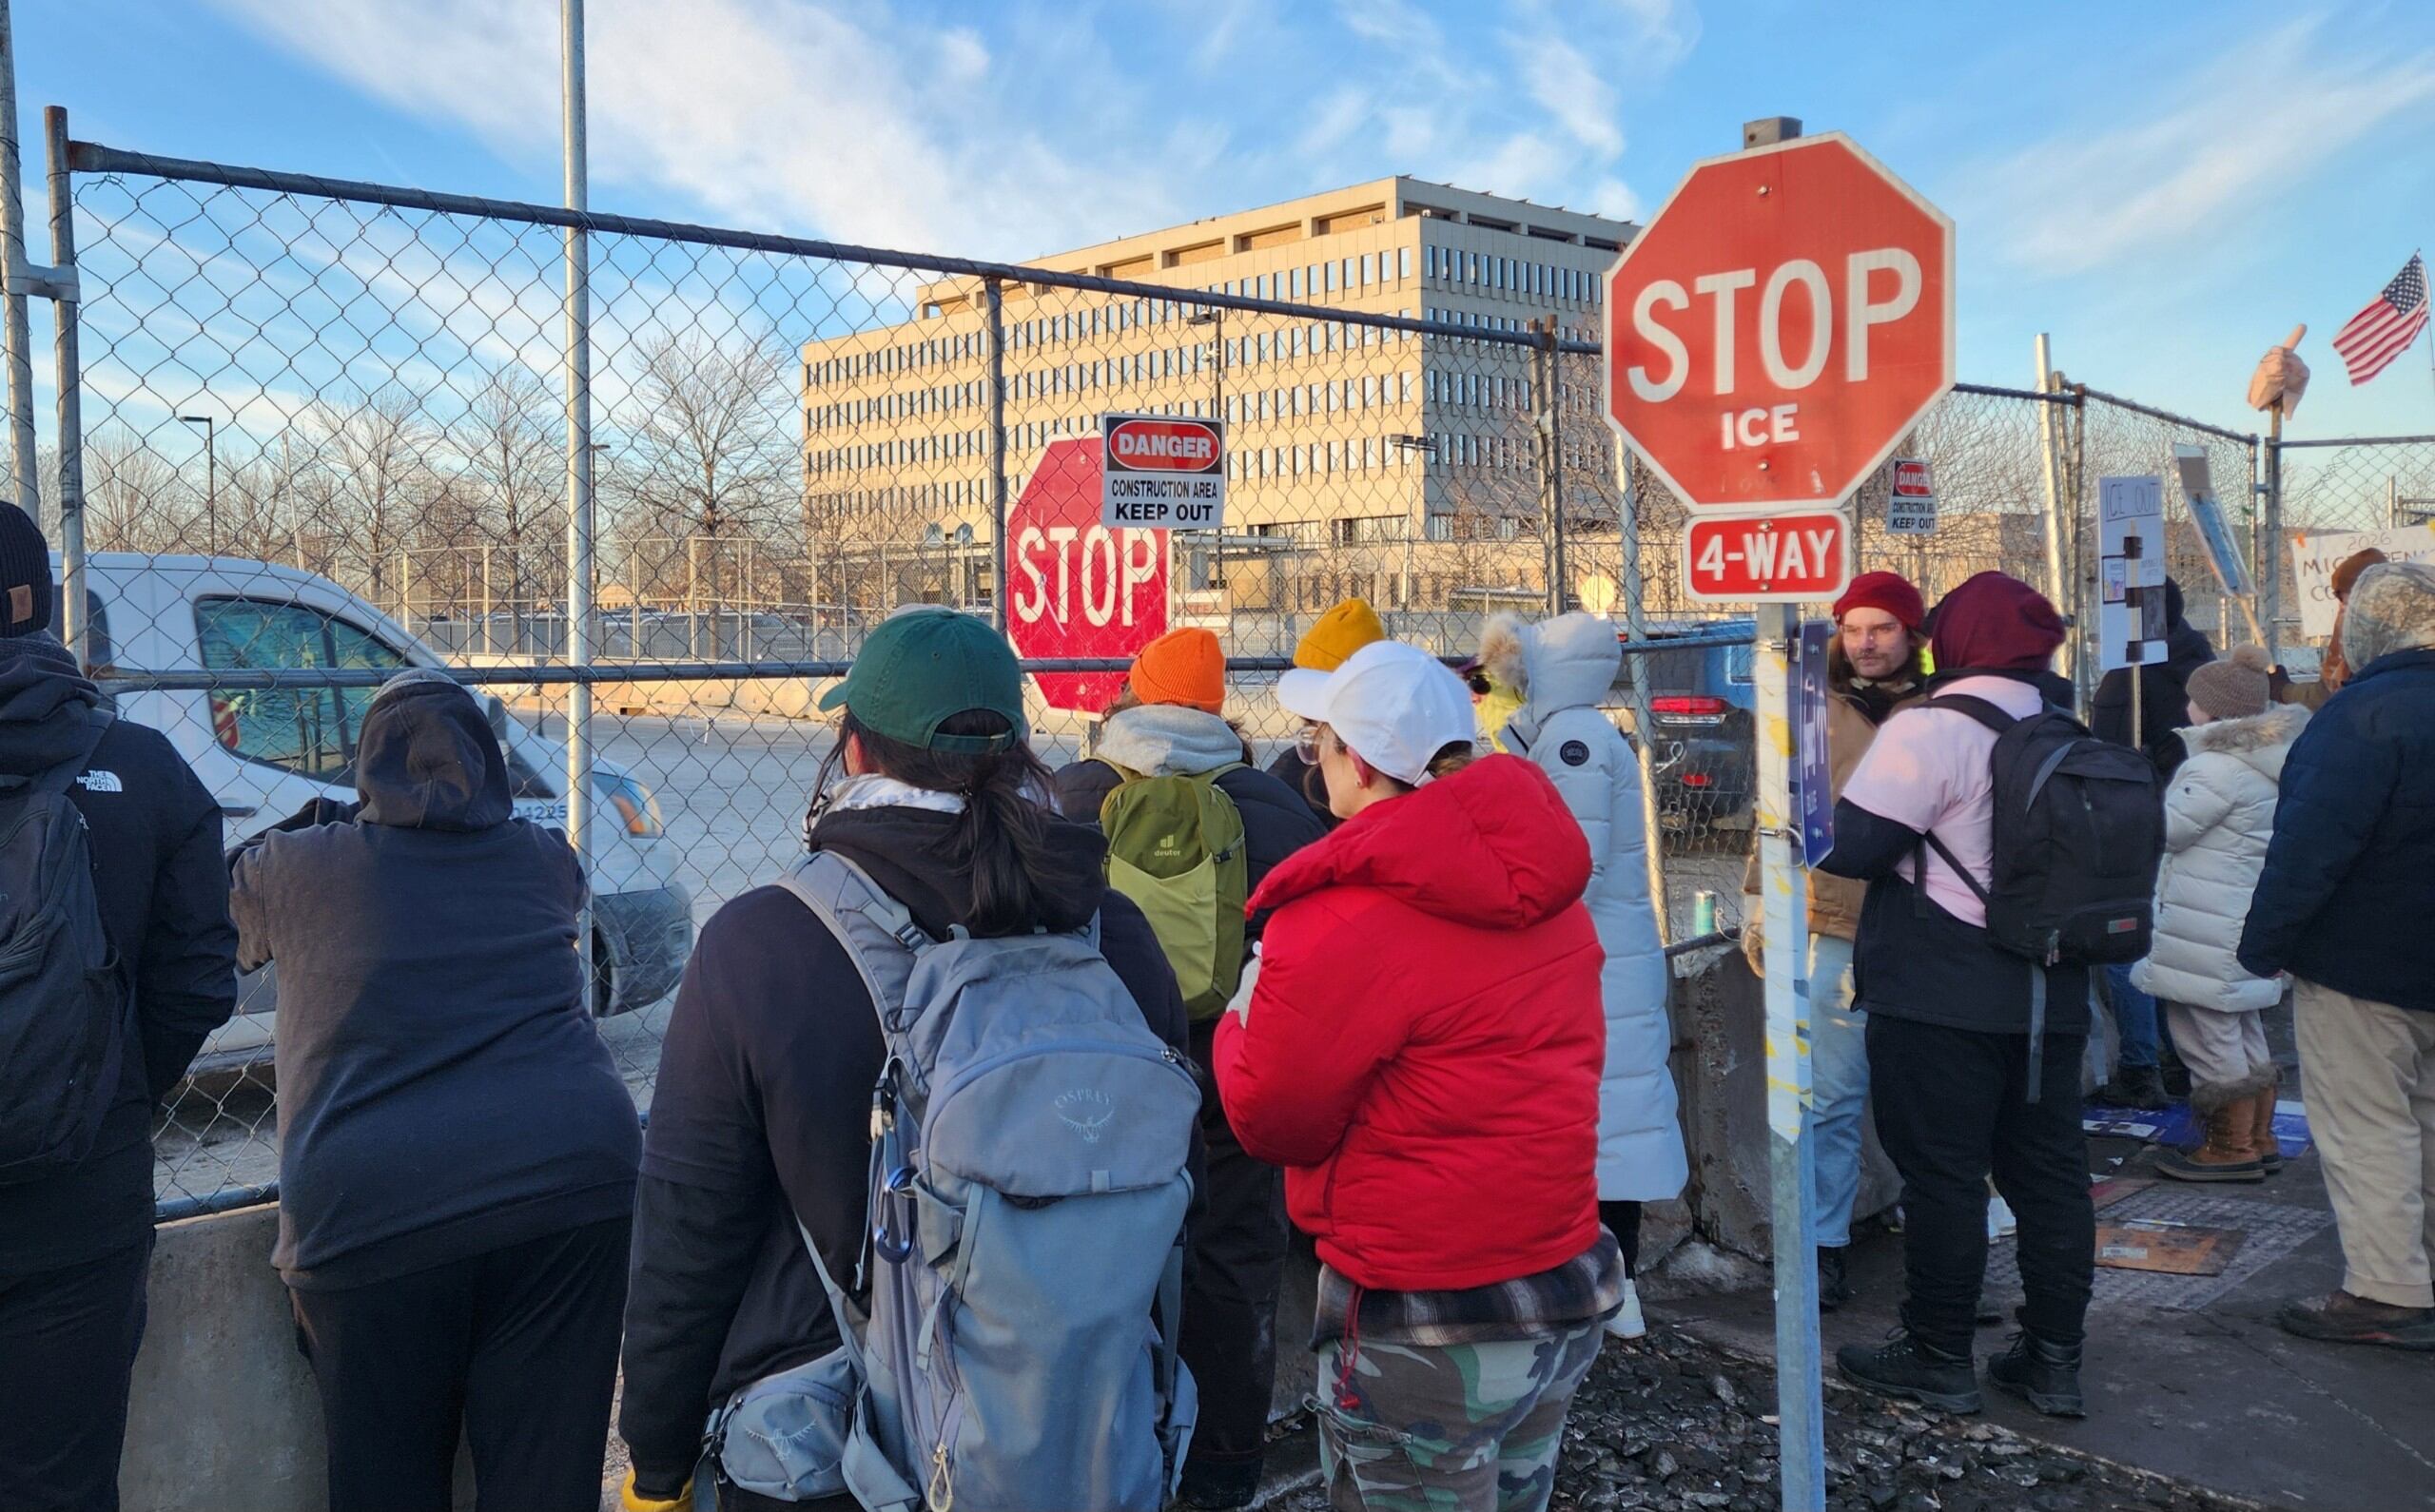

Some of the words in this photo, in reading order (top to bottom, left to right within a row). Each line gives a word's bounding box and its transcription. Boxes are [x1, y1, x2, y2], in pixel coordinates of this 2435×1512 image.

[1627, 247, 1922, 402] STOP
[1721, 403, 1800, 450] ICE
[1118, 433, 1212, 458] DANGER
[1112, 479, 1189, 497] CONSTRUCTION
[1193, 482, 1218, 498] AREA
[2105, 483, 2125, 518] ICE
[2134, 482, 2160, 514] OUT
[1115, 503, 1168, 520] KEEP
[1176, 504, 1213, 521] OUT
[1892, 517, 1916, 529] KEEP
[1919, 517, 1936, 529] OUT
[1697, 529, 1835, 581] 4-WAY
[2347, 533, 2392, 551] 2026
[1014, 524, 1158, 627] STOP
